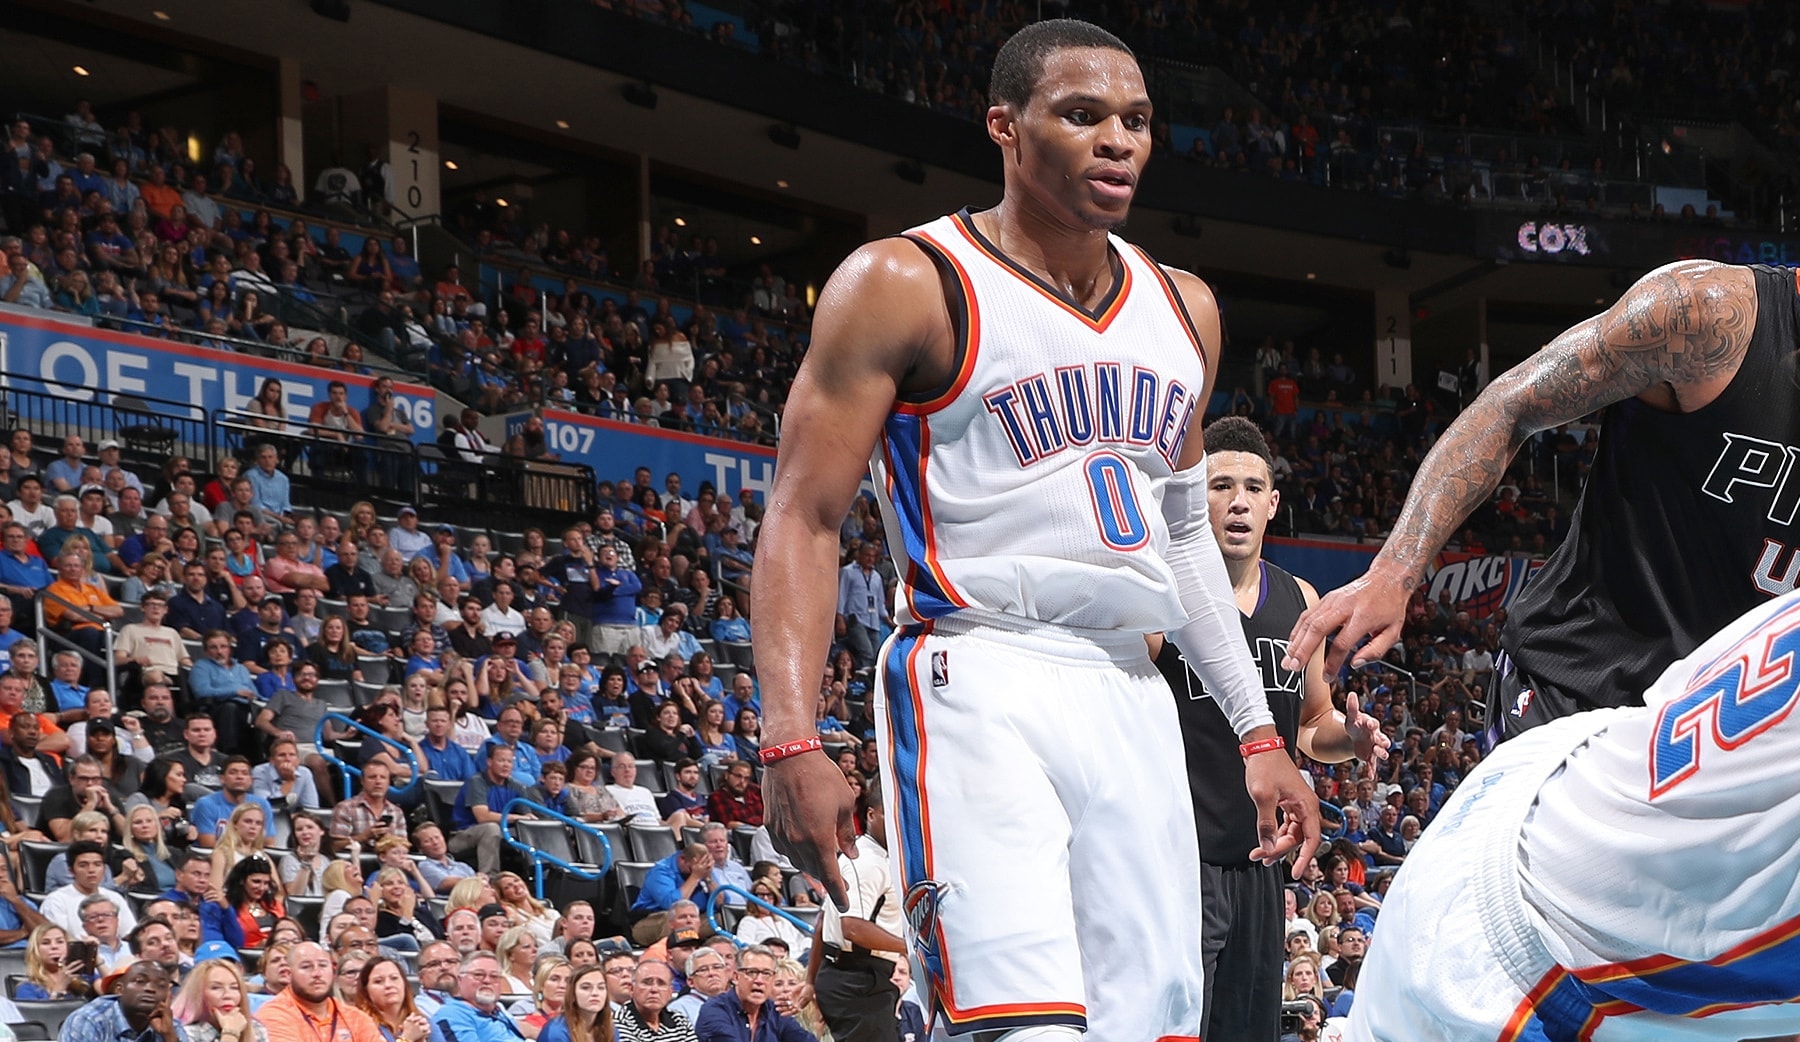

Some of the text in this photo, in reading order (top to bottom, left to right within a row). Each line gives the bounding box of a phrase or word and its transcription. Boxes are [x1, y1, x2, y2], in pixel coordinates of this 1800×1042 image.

[1517, 221, 1591, 256] COX
[40, 341, 148, 402] OF
[173, 361, 314, 436] THE
[393, 396, 434, 428] 06
[546, 423, 596, 455] 107
[1083, 450, 1151, 552] 0
[1426, 556, 1507, 604] OKC
